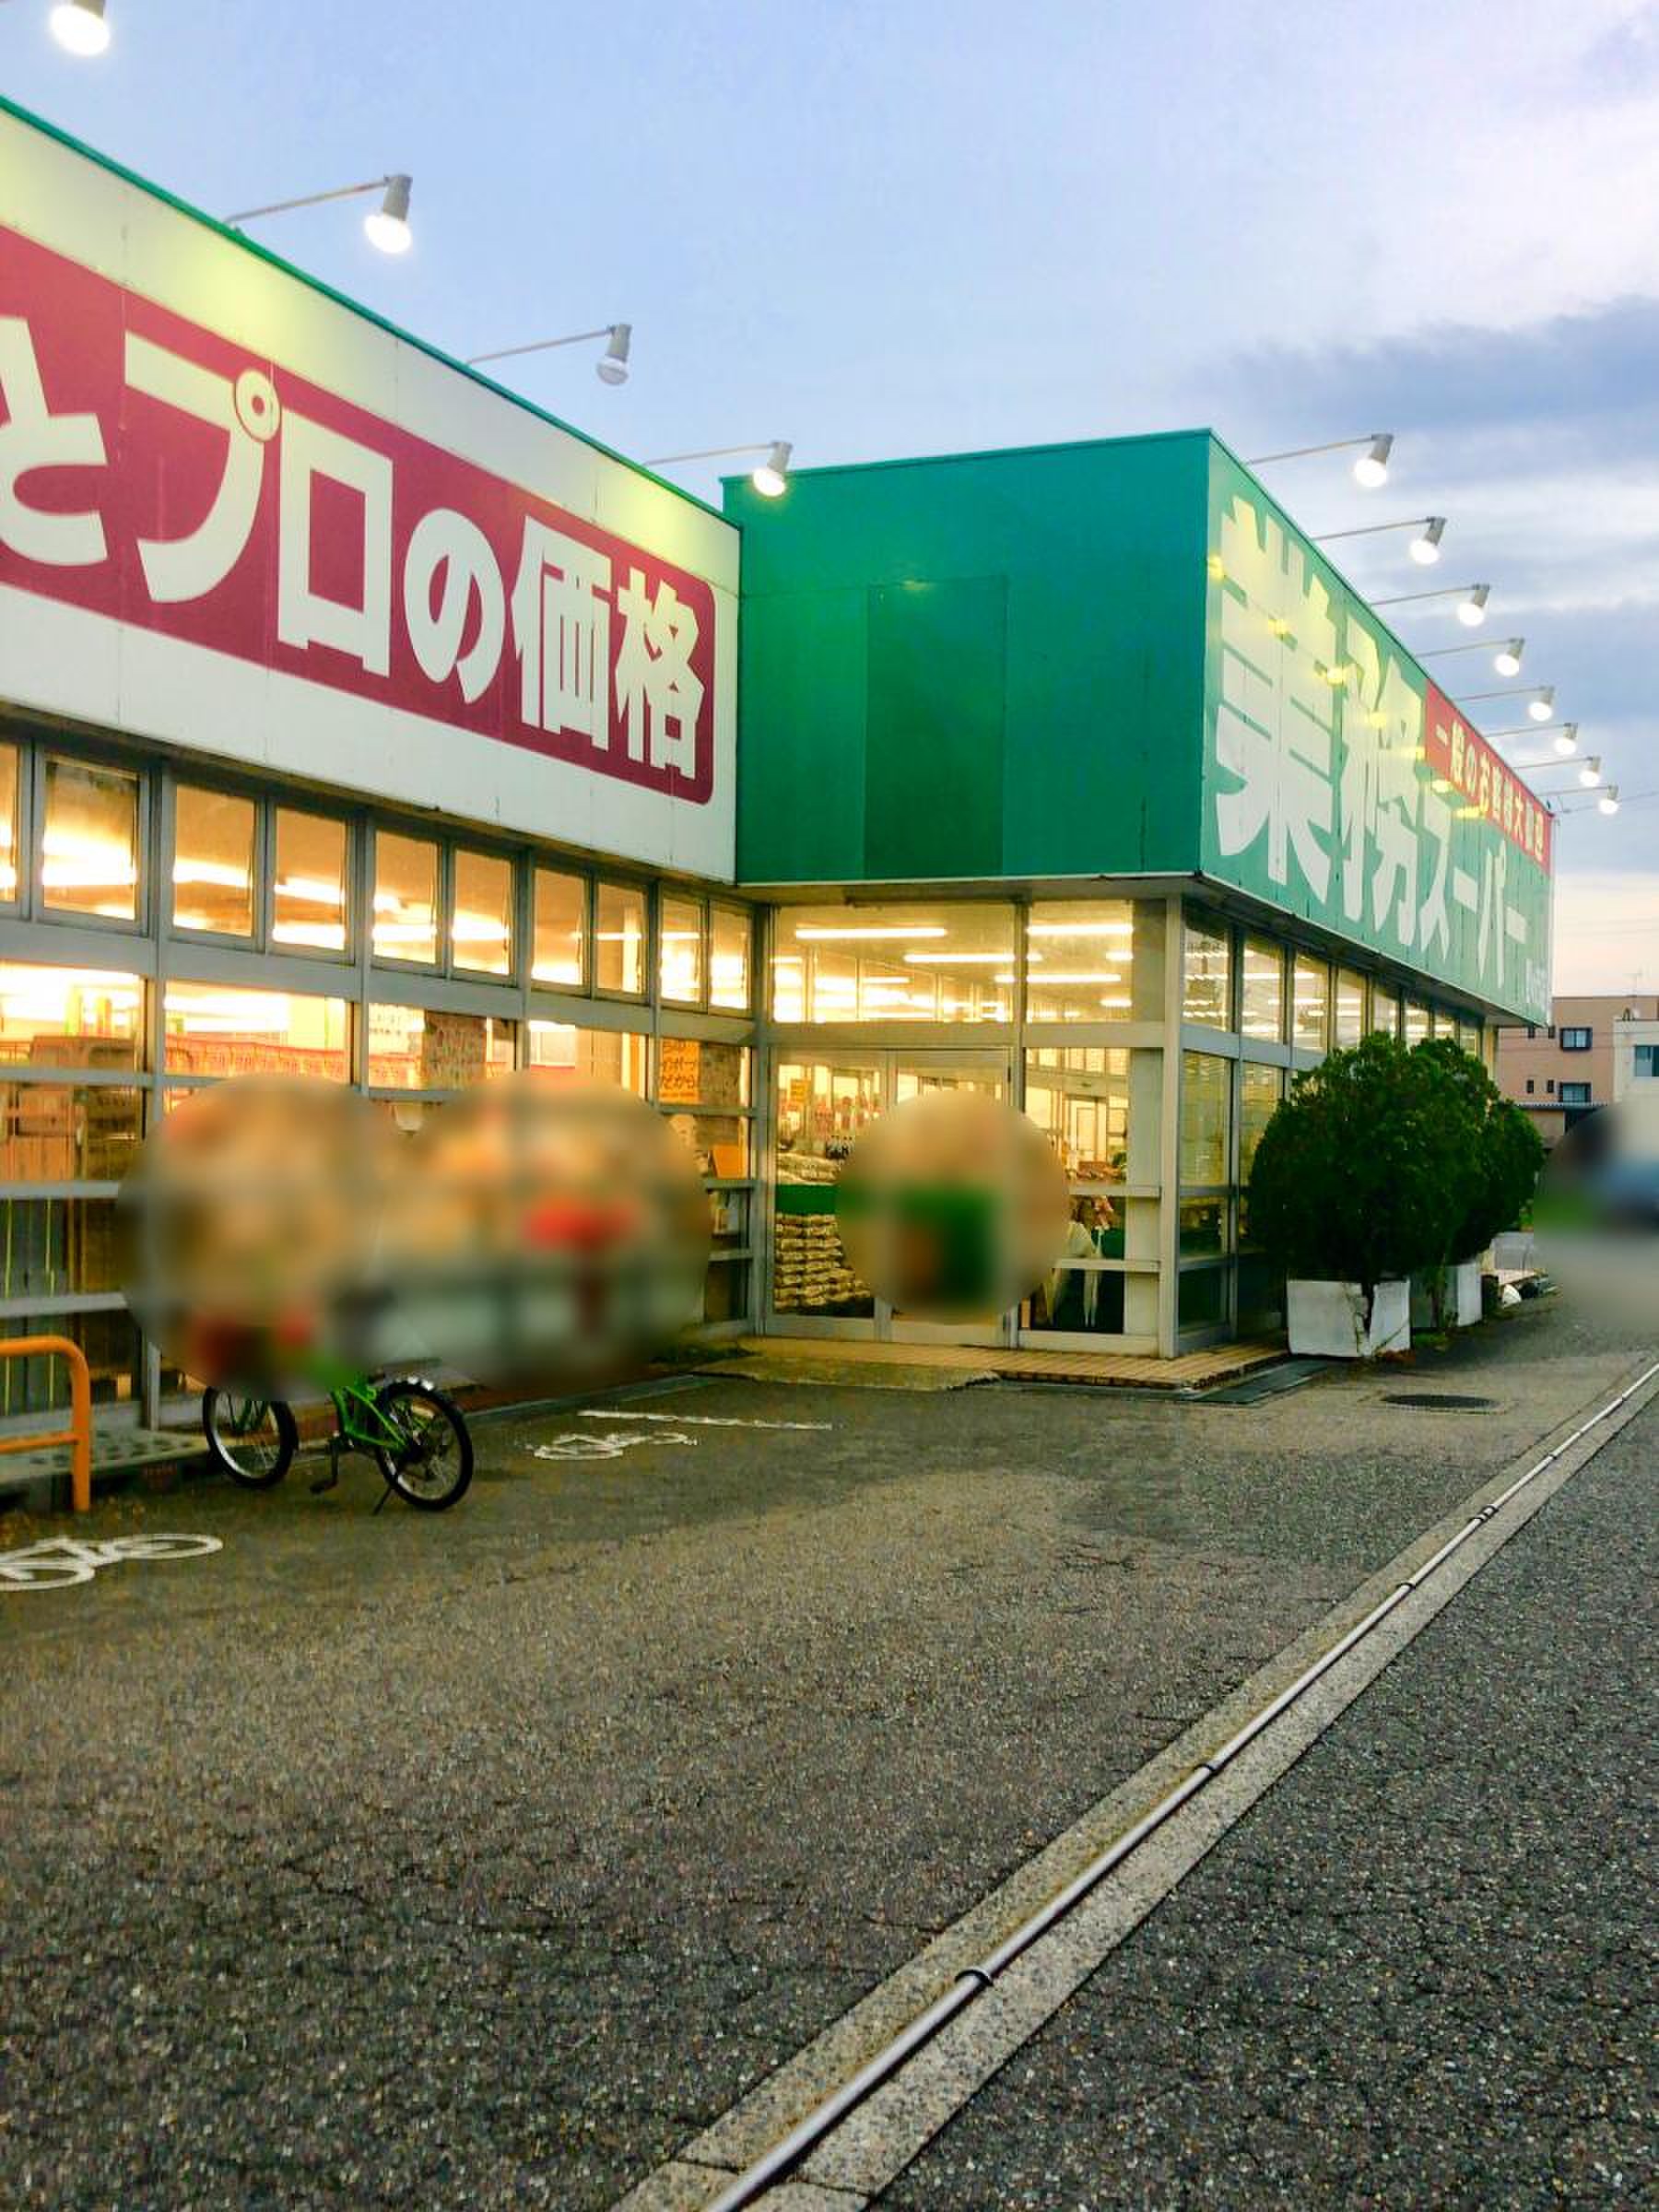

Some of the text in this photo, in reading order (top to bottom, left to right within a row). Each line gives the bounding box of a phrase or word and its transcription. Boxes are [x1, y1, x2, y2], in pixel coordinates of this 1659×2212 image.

[1216, 495, 1527, 989] 業務スーパー
